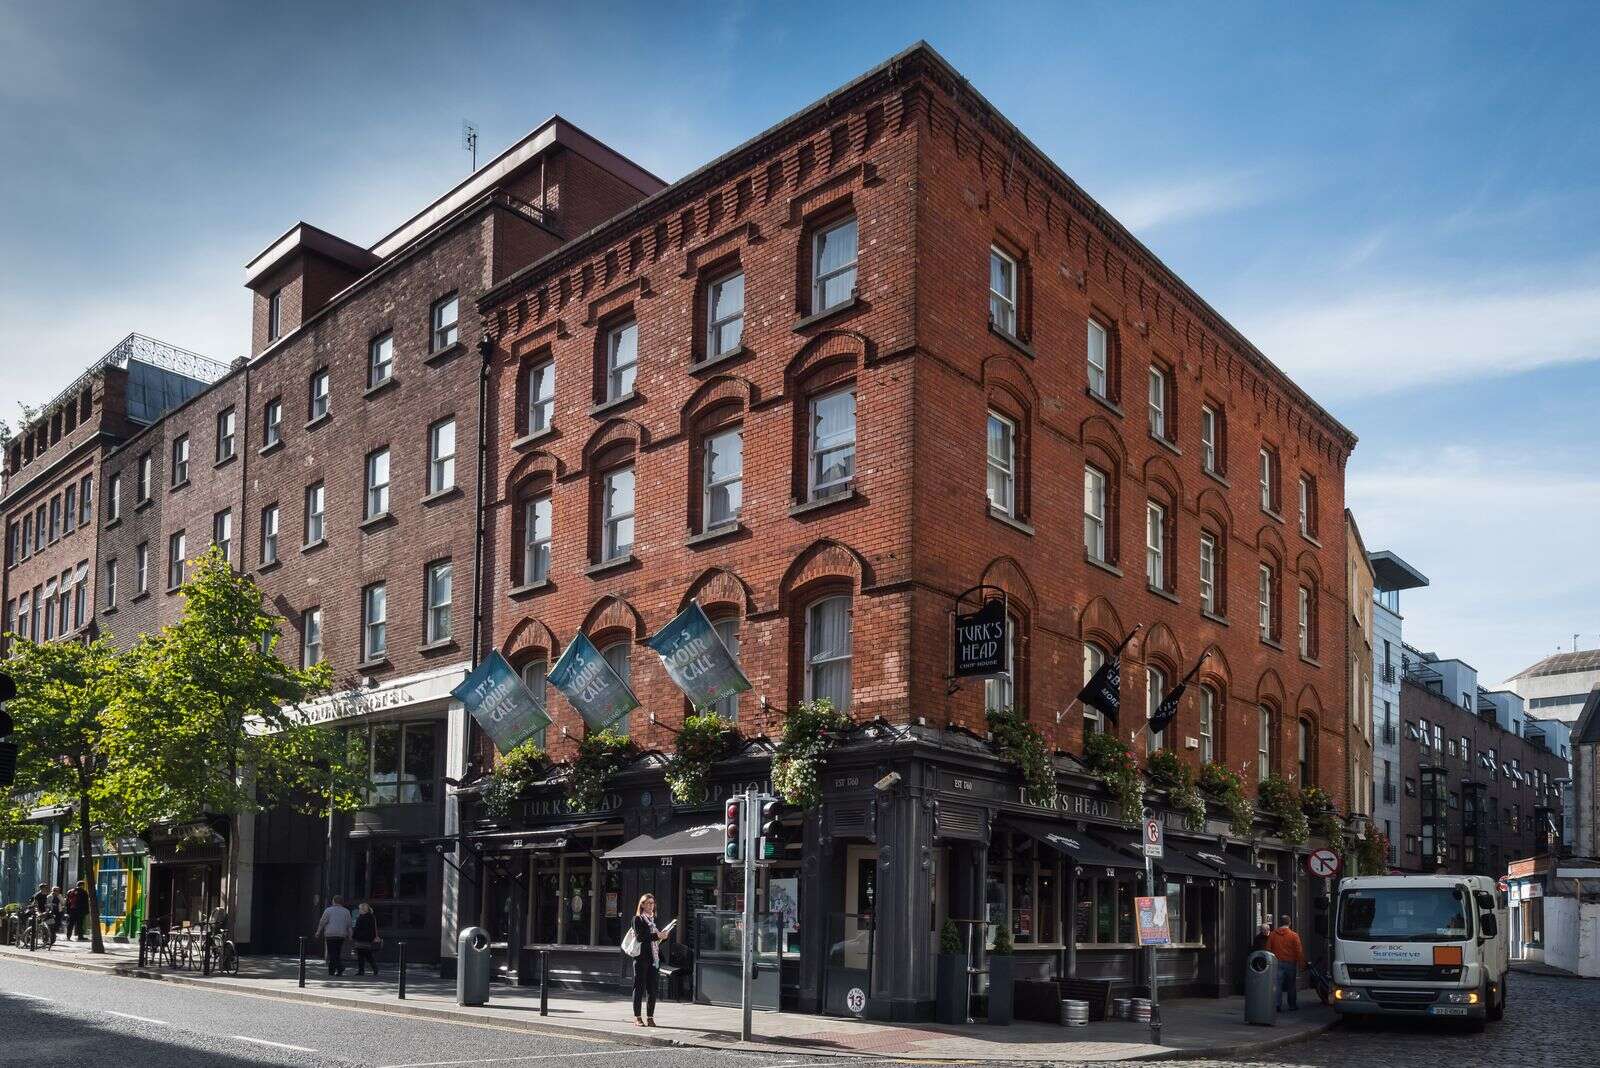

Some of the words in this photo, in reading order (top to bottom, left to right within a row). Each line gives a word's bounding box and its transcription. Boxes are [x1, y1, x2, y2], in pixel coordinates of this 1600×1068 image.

[957, 622, 1003, 643] TURK'S
[666, 638, 708, 668] YOUR
[962, 641, 997, 661] HEAD
[568, 661, 602, 694] YOUR
[683, 655, 716, 681] CALL
[475, 675, 496, 699] IT'S
[479, 682, 511, 712] YOUR
[582, 676, 609, 703] CALL
[490, 697, 518, 722] CALL
[1075, 797, 1109, 818] HEAD
[661, 857, 673, 866] TH
[849, 995, 862, 1006] 13
